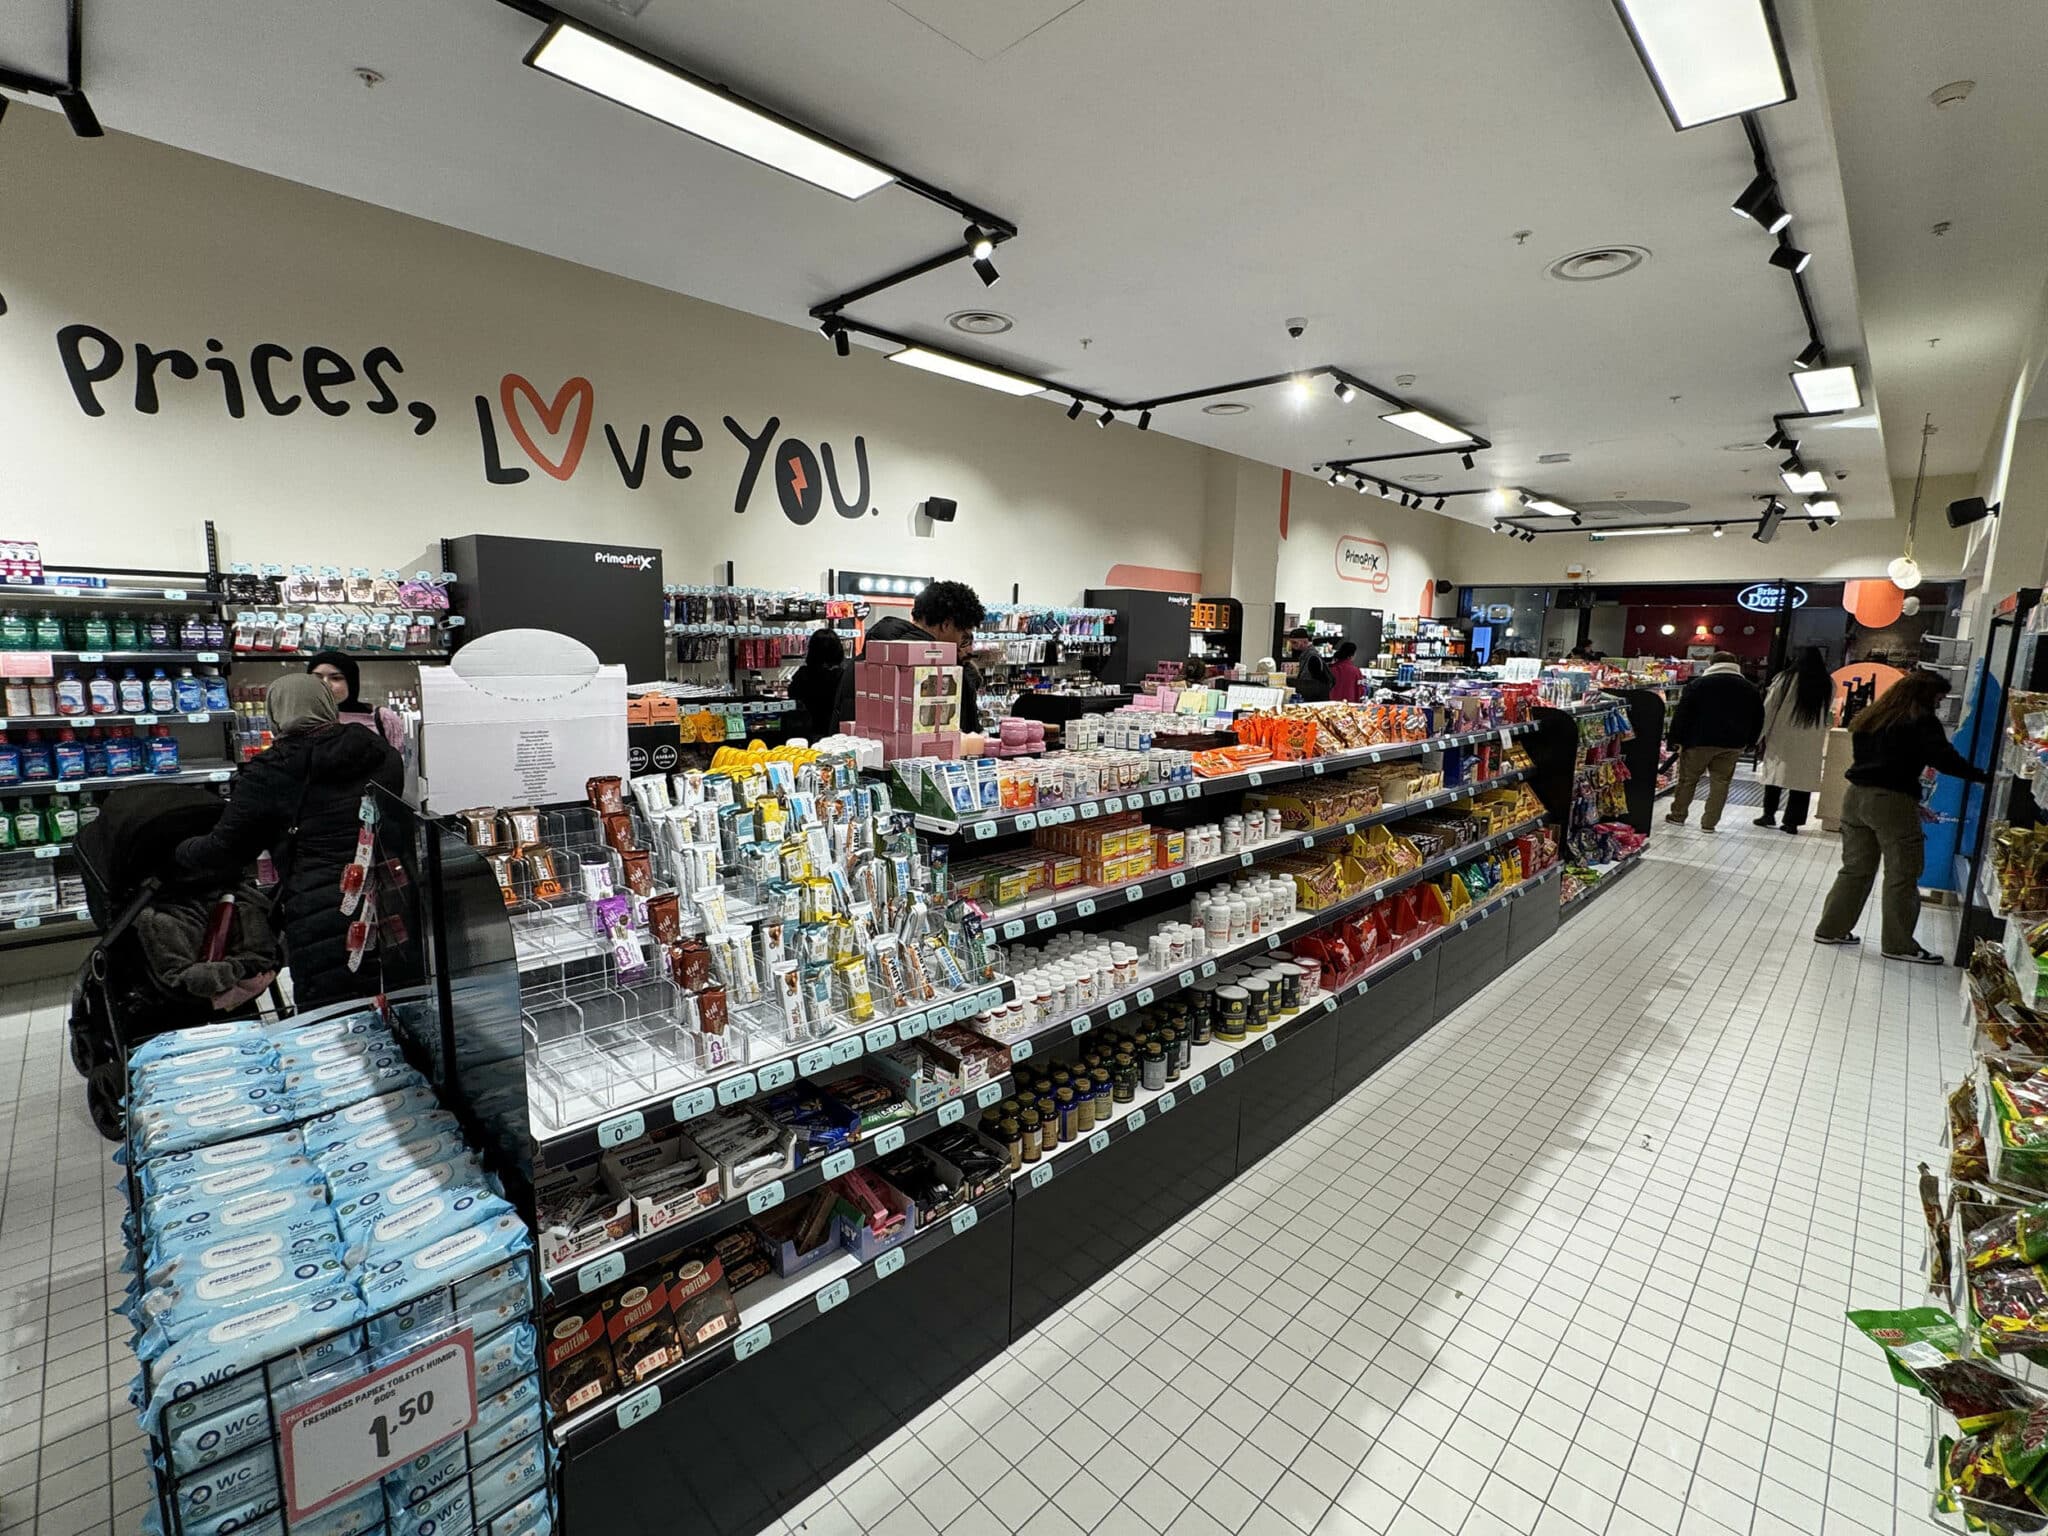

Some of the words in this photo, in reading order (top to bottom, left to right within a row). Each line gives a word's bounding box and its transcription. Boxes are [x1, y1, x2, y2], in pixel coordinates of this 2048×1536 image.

[56, 324, 437, 436] Prices,
[723, 415, 880, 526] YOU.
[316, 1343, 334, 1357] 80
[302, 1399, 354, 1428] FRESHNESS
[354, 1383, 386, 1404] PAPIER
[387, 1364, 425, 1388] TOILETTE
[426, 1349, 458, 1370] HUMIDE
[225, 1413, 260, 1436] WC
[368, 1391, 435, 1458] 1,50
[216, 1467, 251, 1491] WC
[428, 1463, 456, 1486] WC
[437, 1498, 465, 1521] WC
